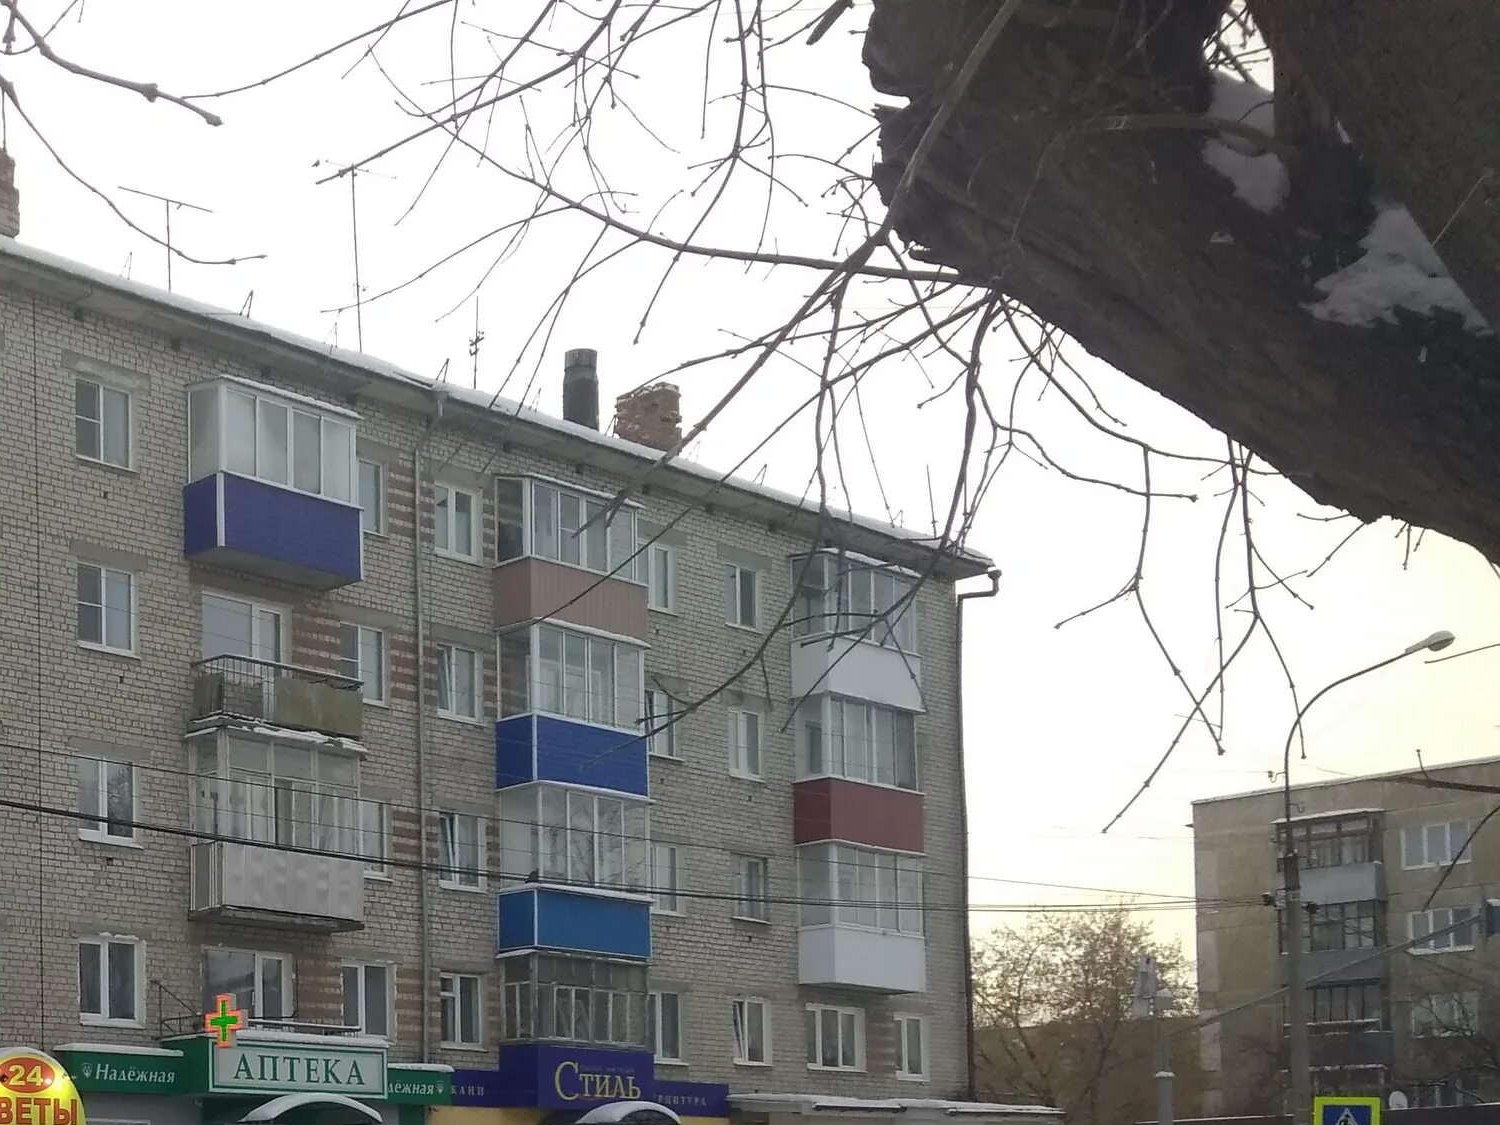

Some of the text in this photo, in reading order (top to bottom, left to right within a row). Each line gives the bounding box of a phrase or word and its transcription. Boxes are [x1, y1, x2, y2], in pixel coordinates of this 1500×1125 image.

[8, 1064, 43, 1087] 24
[95, 1063, 176, 1083] Надёжная
[233, 1053, 366, 1085] АПТЕКА
